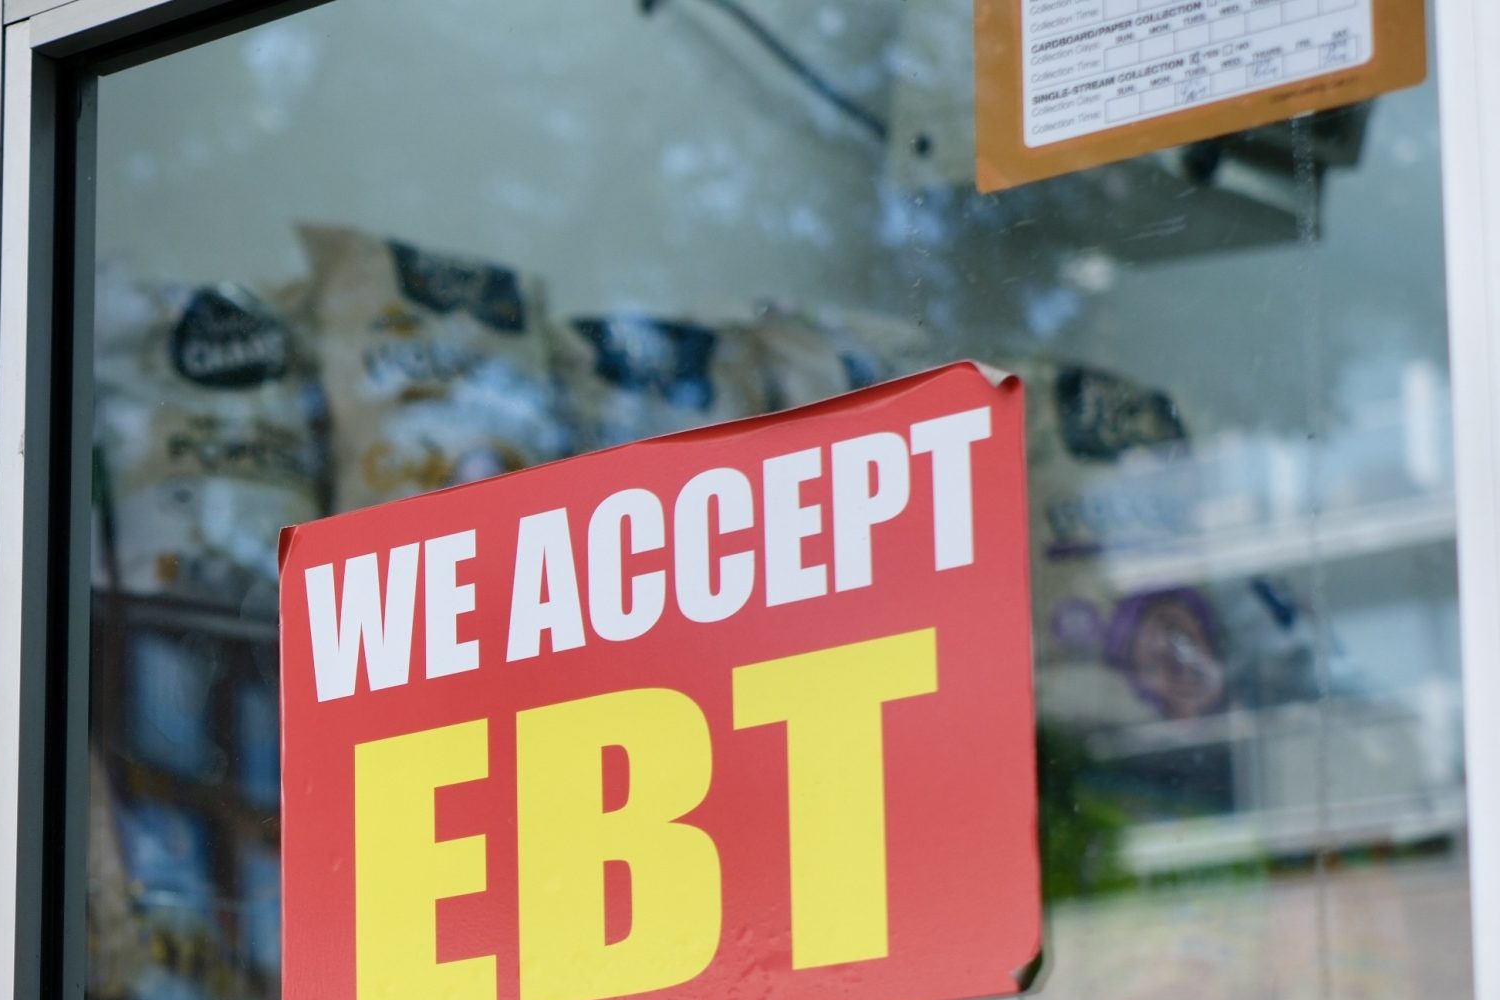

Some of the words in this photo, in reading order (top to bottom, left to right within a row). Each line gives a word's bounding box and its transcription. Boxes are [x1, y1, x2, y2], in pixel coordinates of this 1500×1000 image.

[1030, 13, 1073, 33] Collection
[1031, 20, 1132, 54] CARDBOARD/PAPER
[1135, 2, 1202, 26] COLLECTION
[1031, 46, 1073, 66] Collection
[1031, 64, 1074, 83] Collection
[1032, 77, 1115, 105] SINGLE-STREAM
[1117, 58, 1184, 83] COLLECTION
[1032, 97, 1074, 118] Collection
[1032, 115, 1075, 136] Collection
[304, 529, 480, 703] WE
[506, 405, 992, 663] ACCEPT
